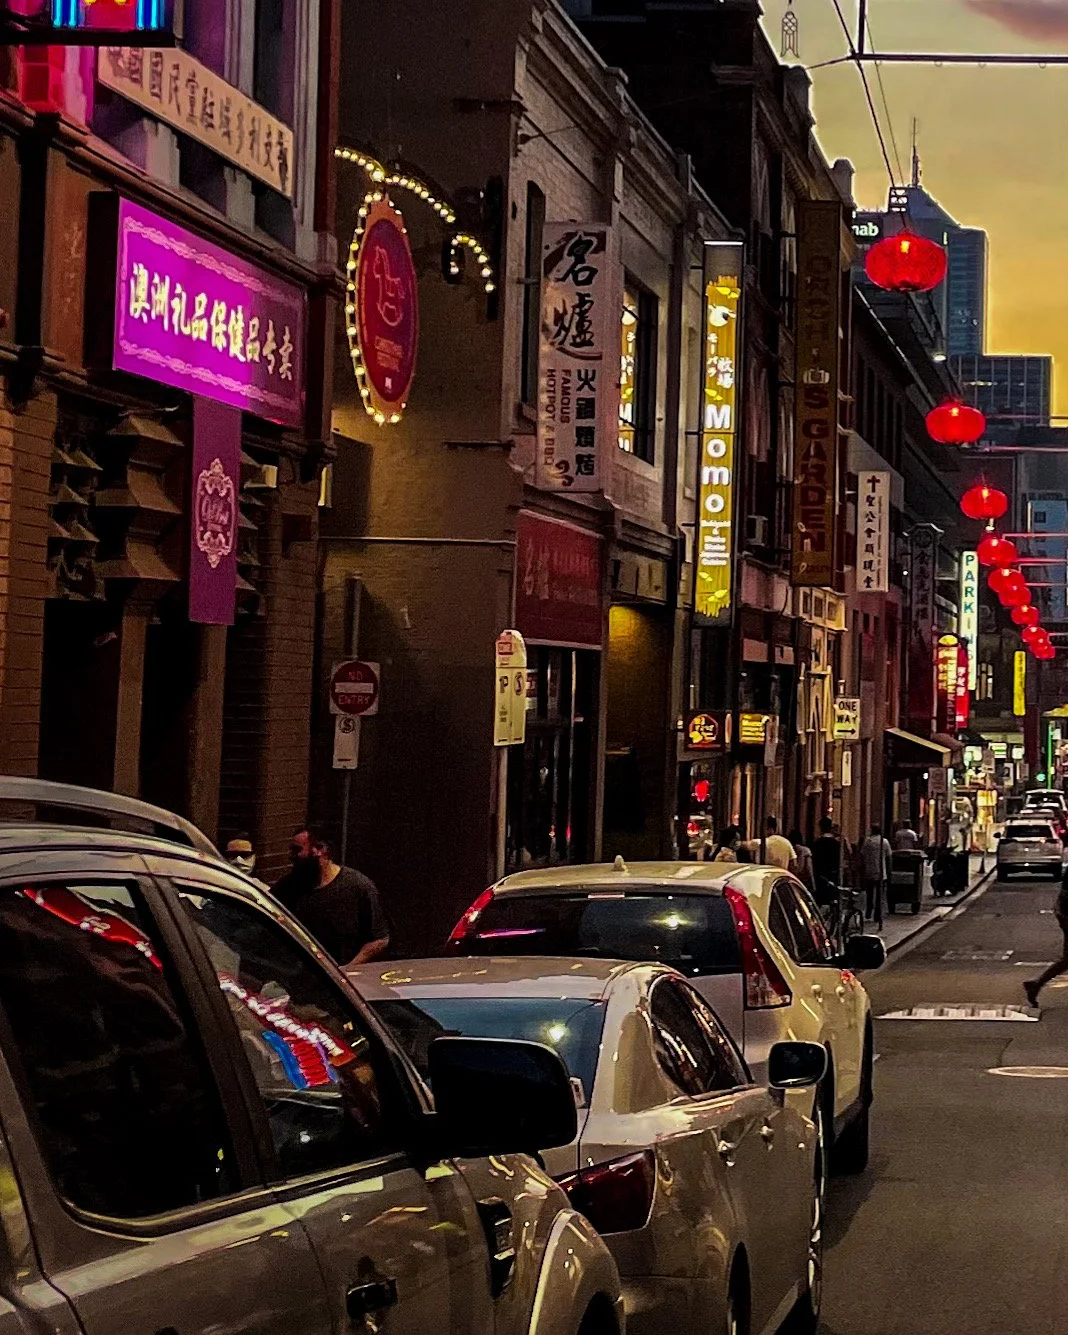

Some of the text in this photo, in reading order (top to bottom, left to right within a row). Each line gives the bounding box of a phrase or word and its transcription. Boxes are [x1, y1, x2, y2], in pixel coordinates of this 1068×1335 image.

[851, 222, 879, 237] nab
[545, 369, 557, 422] HOTPOT
[560, 369, 572, 424] FAMOUS
[700, 403, 732, 514] Momo
[800, 419, 831, 552] GARDEN
[964, 555, 976, 660] PARKING
[348, 671, 364, 681] NO
[338, 695, 371, 705] ENTRY
[839, 701, 857, 711] ONE
[837, 715, 858, 724] WAY
